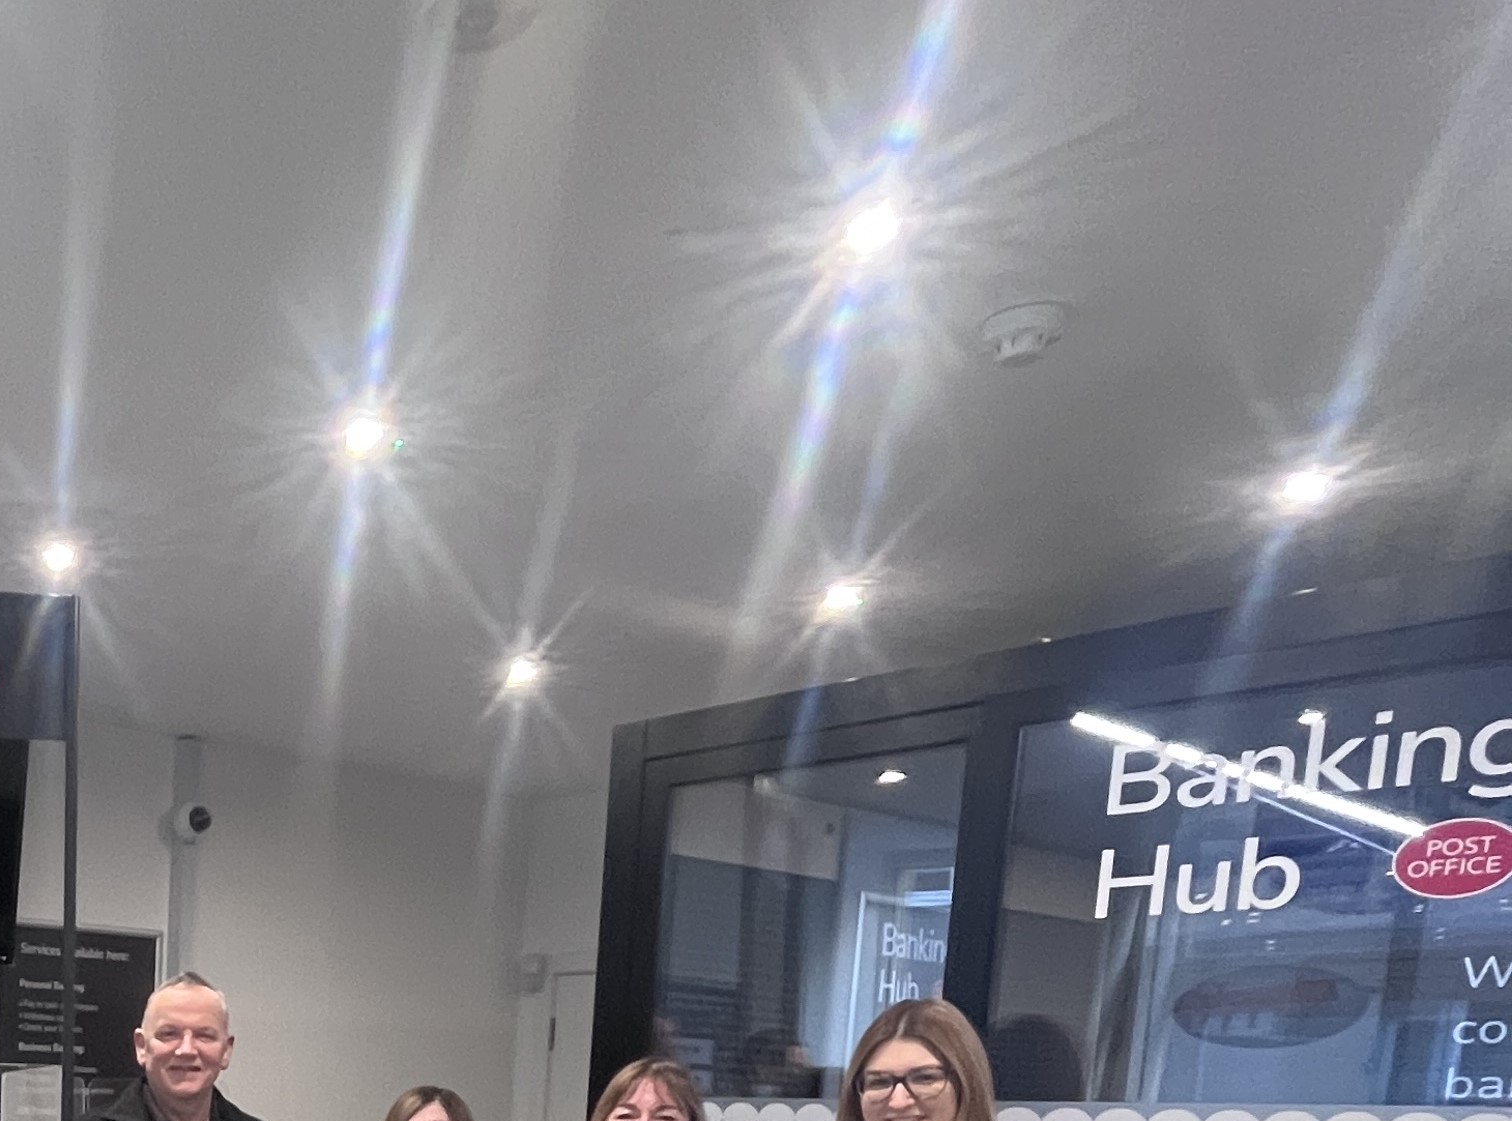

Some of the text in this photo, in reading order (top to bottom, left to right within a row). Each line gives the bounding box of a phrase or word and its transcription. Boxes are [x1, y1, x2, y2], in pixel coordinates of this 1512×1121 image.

[1106, 710, 1512, 816] Banking
[1426, 836, 1497, 857] POST
[1094, 837, 1301, 919] Hub
[1407, 855, 1503, 878] OFFICE
[882, 922, 947, 963] Bankin
[1445, 1067, 1512, 1100] ba
